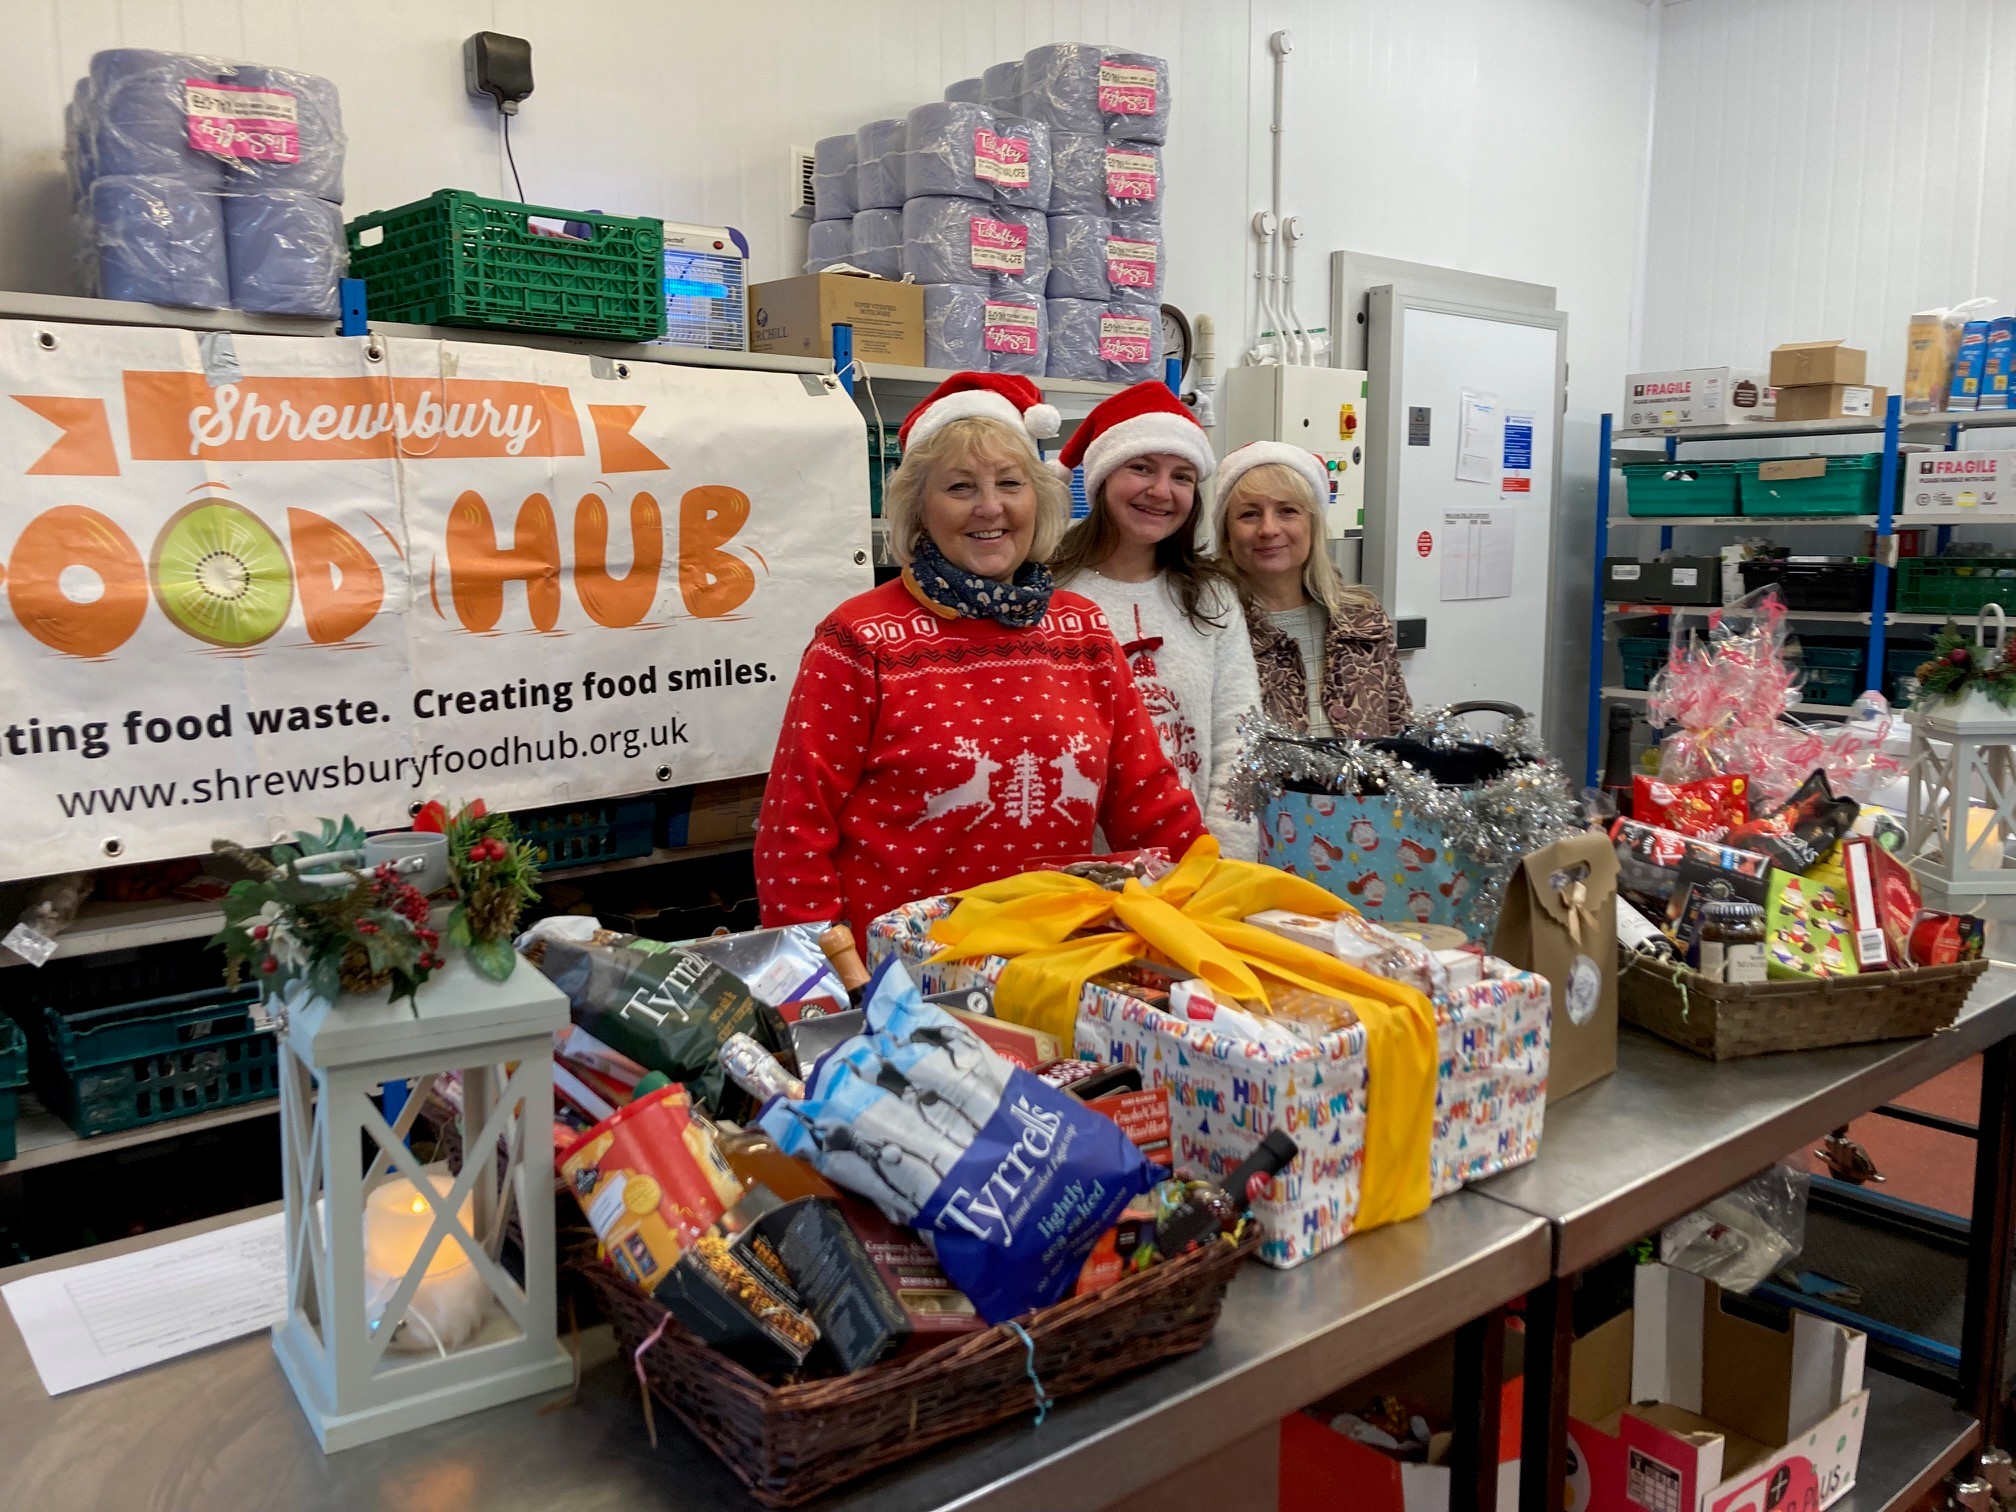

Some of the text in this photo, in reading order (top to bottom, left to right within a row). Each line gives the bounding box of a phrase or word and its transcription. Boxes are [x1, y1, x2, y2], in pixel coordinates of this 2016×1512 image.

[188, 383, 541, 456] Shrewsbury
[1645, 381, 1692, 396] FRAGILE
[1936, 459, 1998, 474] FRAGILE
[0, 485, 755, 657] OOD HUB
[0, 658, 777, 758] ting food waste. Creating food smiles.
[57, 716, 689, 818] www.shrewsburyfoodhub.org.uk
[1233, 1076, 1276, 1110] HOLLY
[934, 1094, 1061, 1248] Tyrrell's
[1037, 1178, 1086, 1239] lightly
